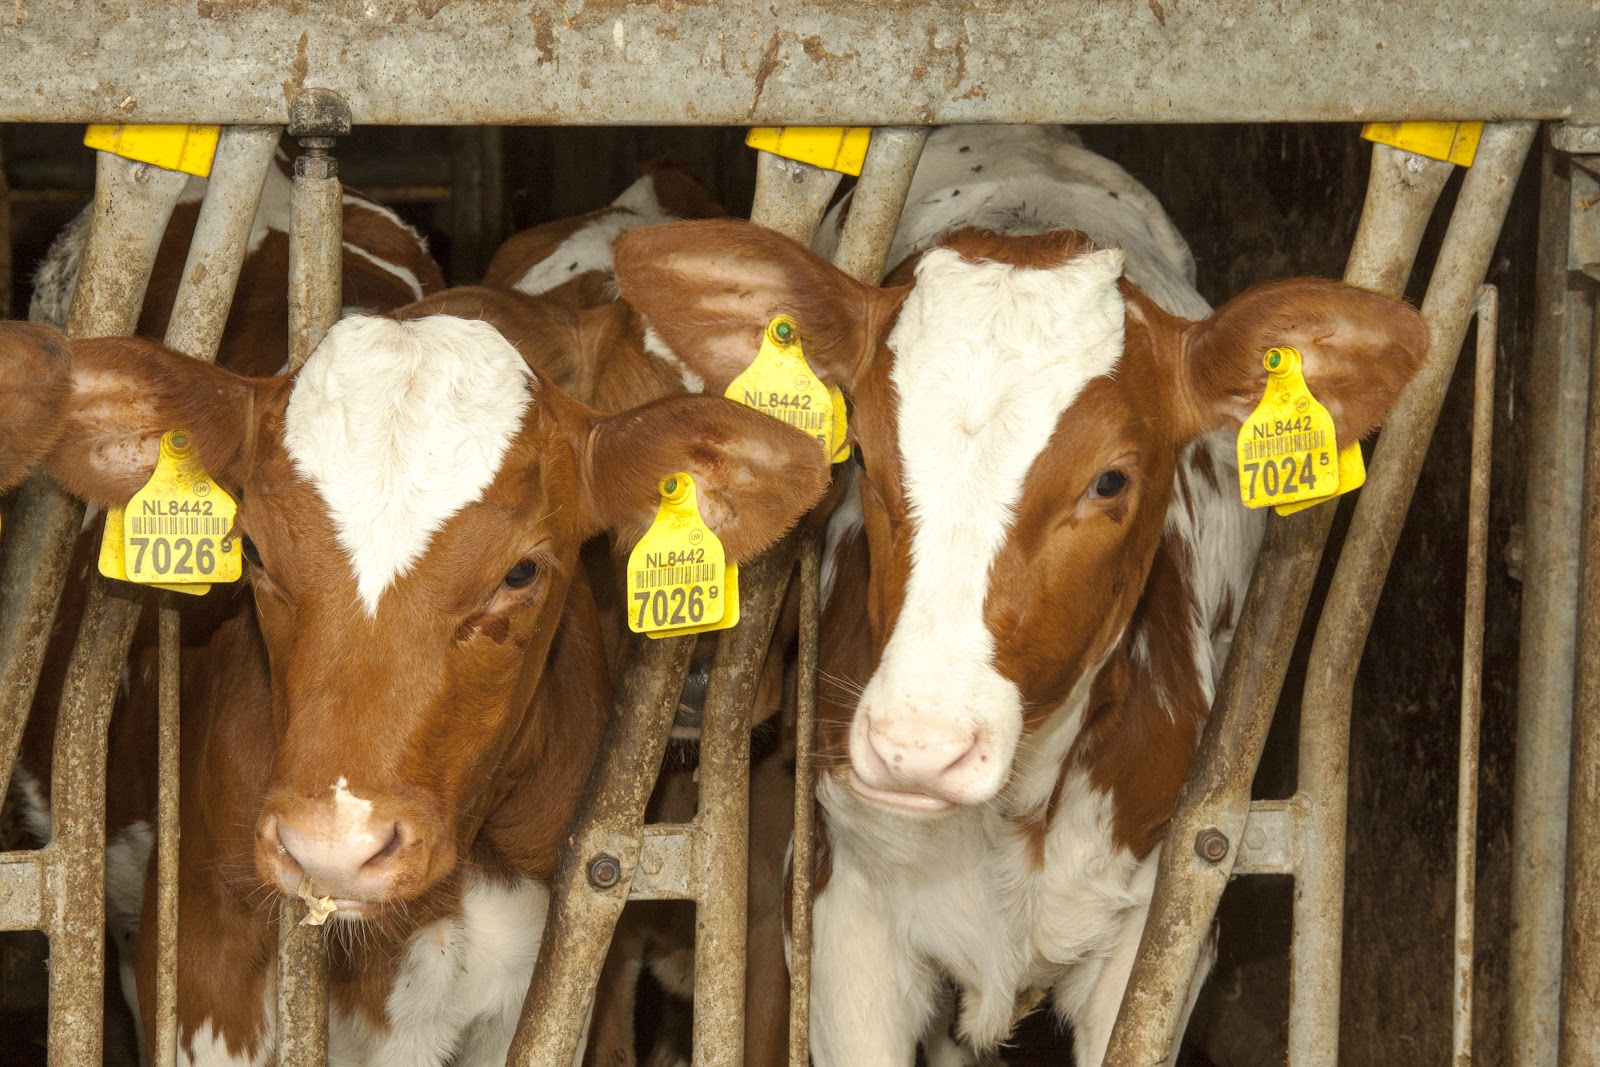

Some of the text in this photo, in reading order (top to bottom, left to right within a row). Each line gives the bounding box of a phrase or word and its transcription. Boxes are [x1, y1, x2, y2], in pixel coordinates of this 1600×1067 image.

[744, 391, 812, 410] NL8442
[1253, 416, 1312, 439] NL8442
[1243, 452, 1330, 500] 7024 5
[142, 500, 214, 516] NL8442
[130, 538, 215, 575] 7026
[646, 548, 705, 568] NL8442
[634, 586, 719, 629] 7026 9
